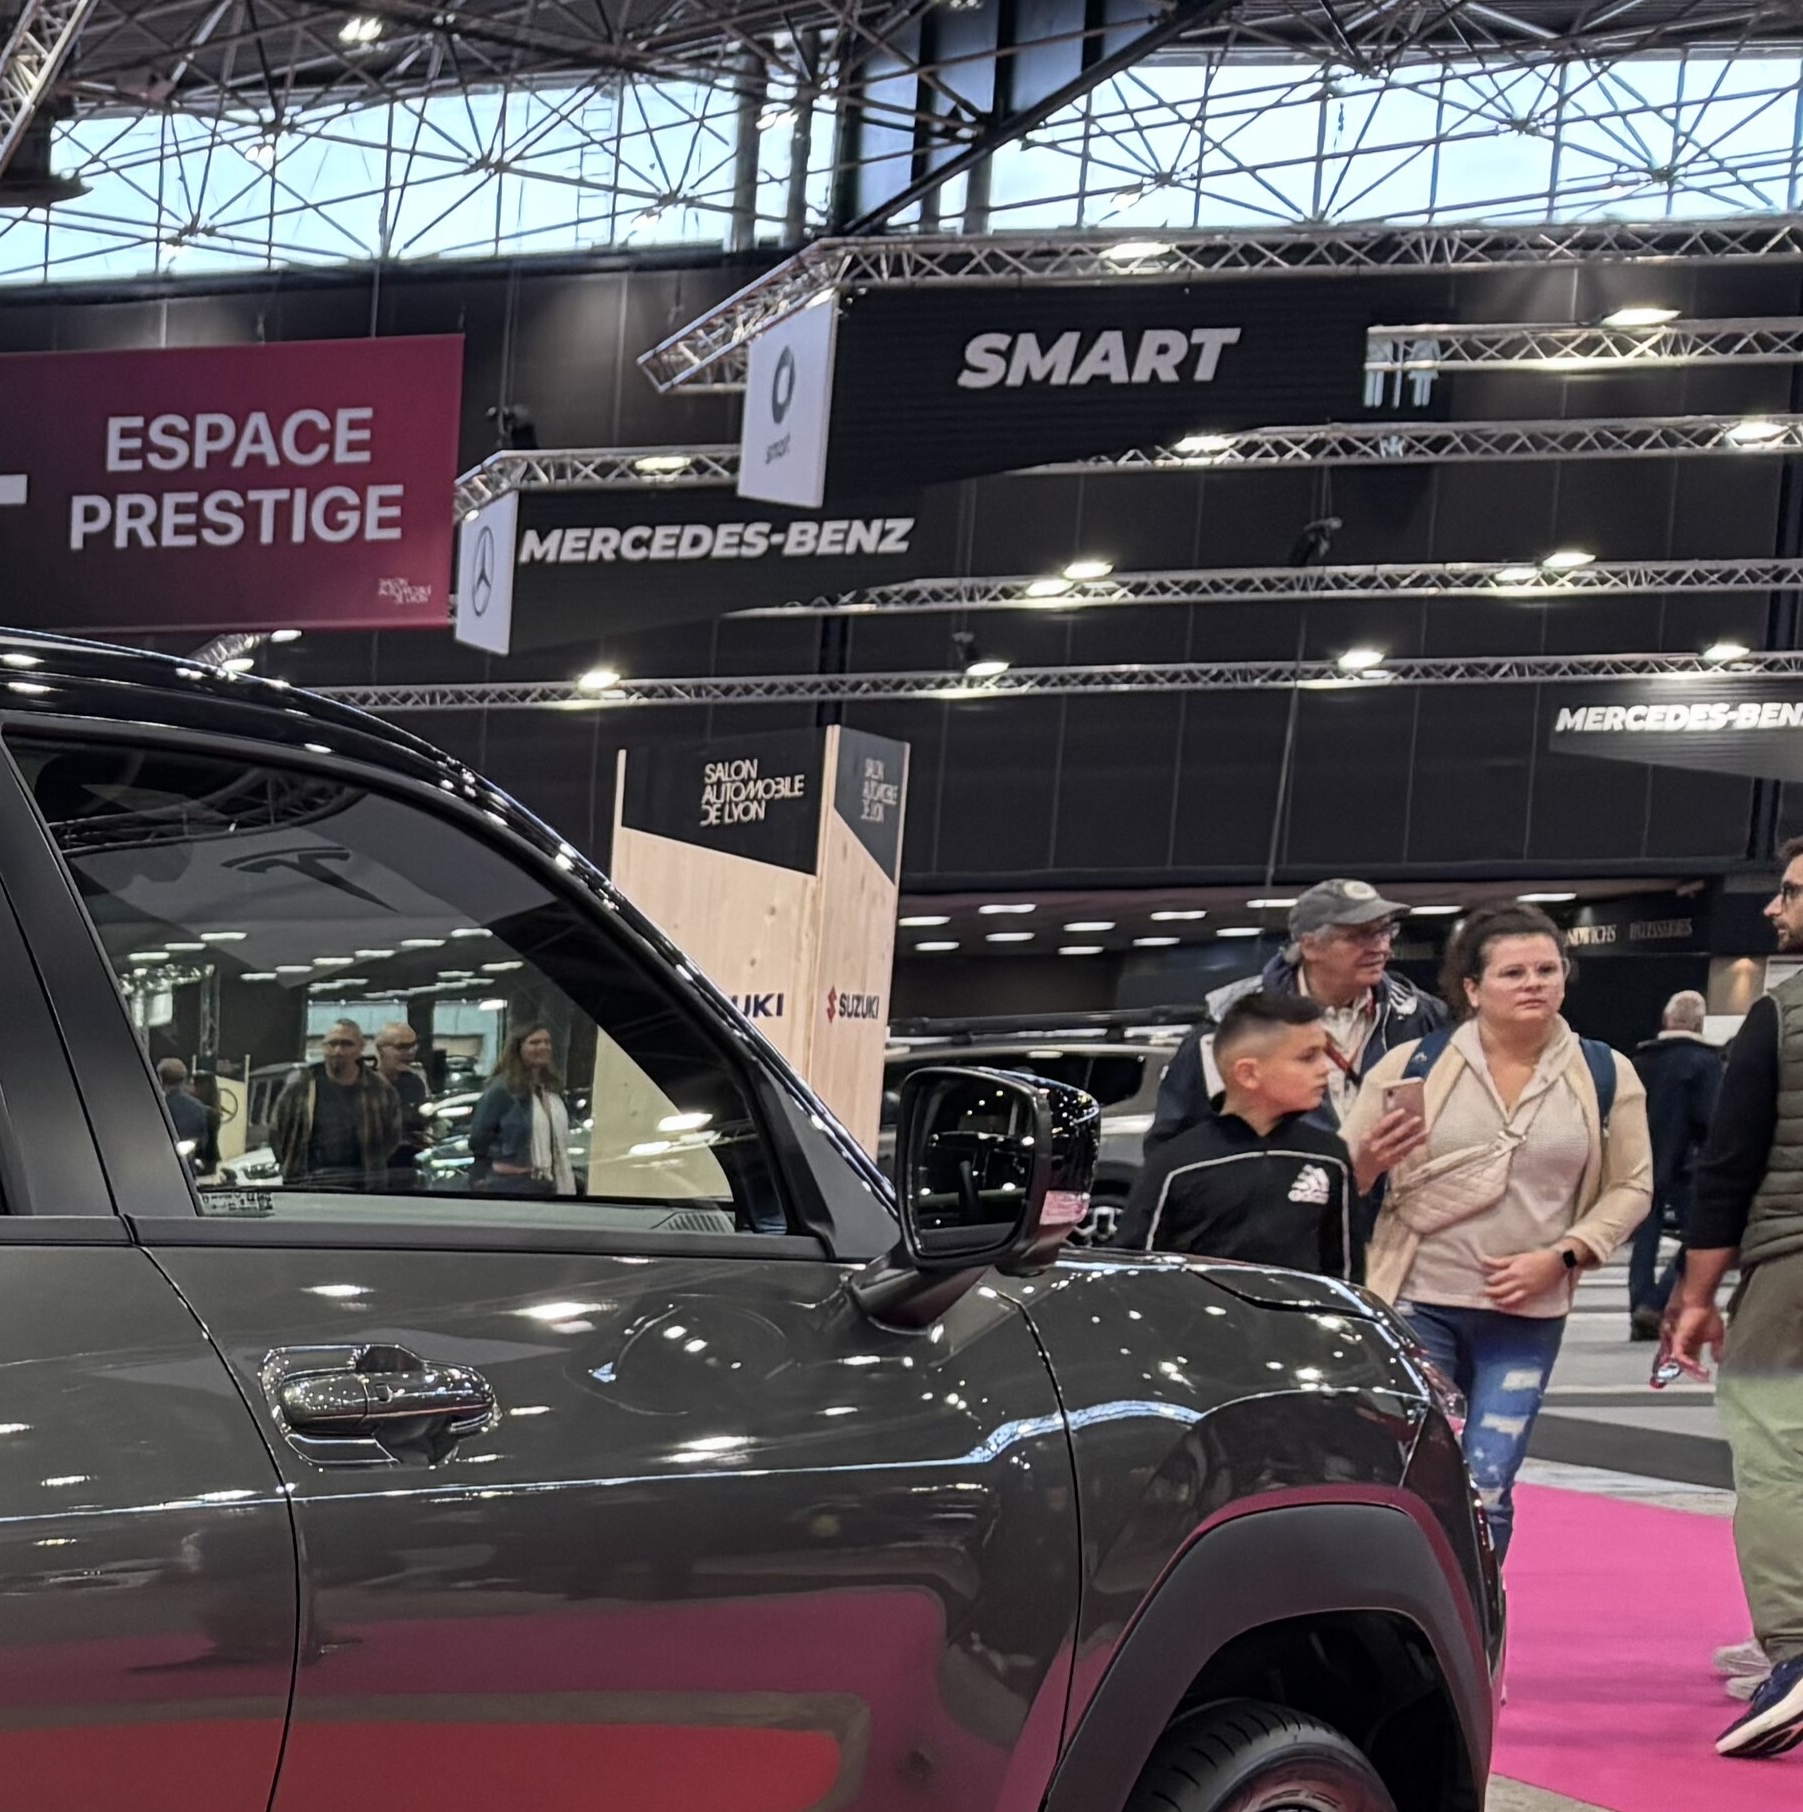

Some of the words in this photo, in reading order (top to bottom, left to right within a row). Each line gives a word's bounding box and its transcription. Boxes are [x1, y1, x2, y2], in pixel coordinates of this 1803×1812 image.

[957, 327, 1242, 388] SMART
[106, 407, 374, 473] ESPACE
[69, 484, 405, 551] PRESTIGE
[519, 518, 915, 564] MERCEDES-BENZ
[1555, 701, 1803, 732] MERCEDES-BEN
[703, 758, 758, 783] SALON
[701, 774, 805, 804] AUTOMOBILE
[724, 800, 767, 824] LYON
[838, 992, 880, 1020] SUZUKI
